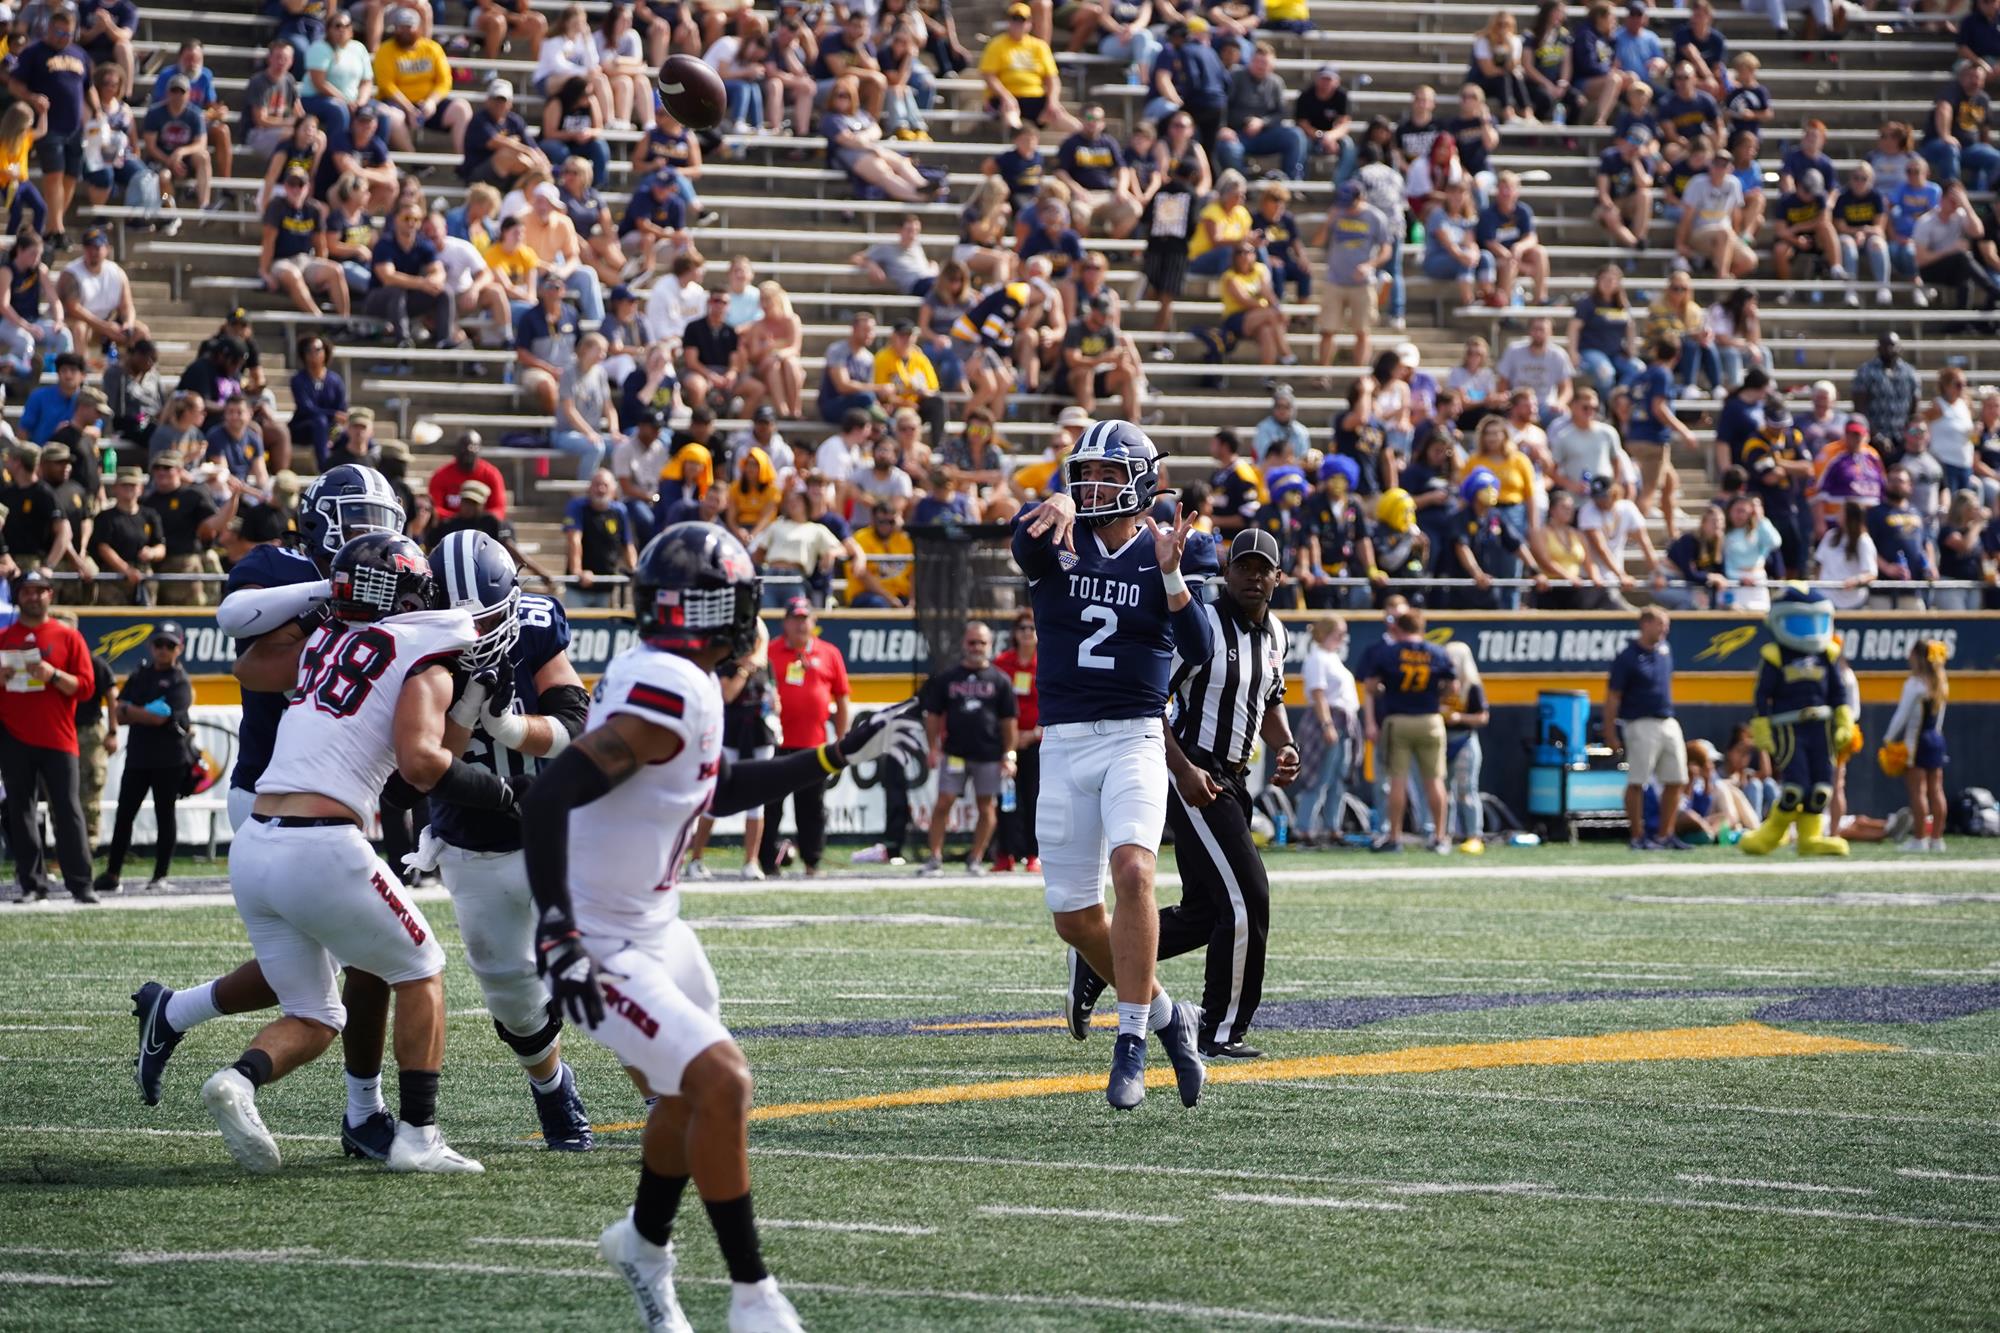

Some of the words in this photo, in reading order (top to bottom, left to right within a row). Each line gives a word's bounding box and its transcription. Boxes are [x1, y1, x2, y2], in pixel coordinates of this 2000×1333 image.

[1068, 574, 1140, 608] TOLEDO
[1077, 604, 1118, 670] 2
[1478, 630, 1558, 662] TOLEDO
[1228, 648, 1238, 662] S
[370, 871, 427, 947] HUSKIES
